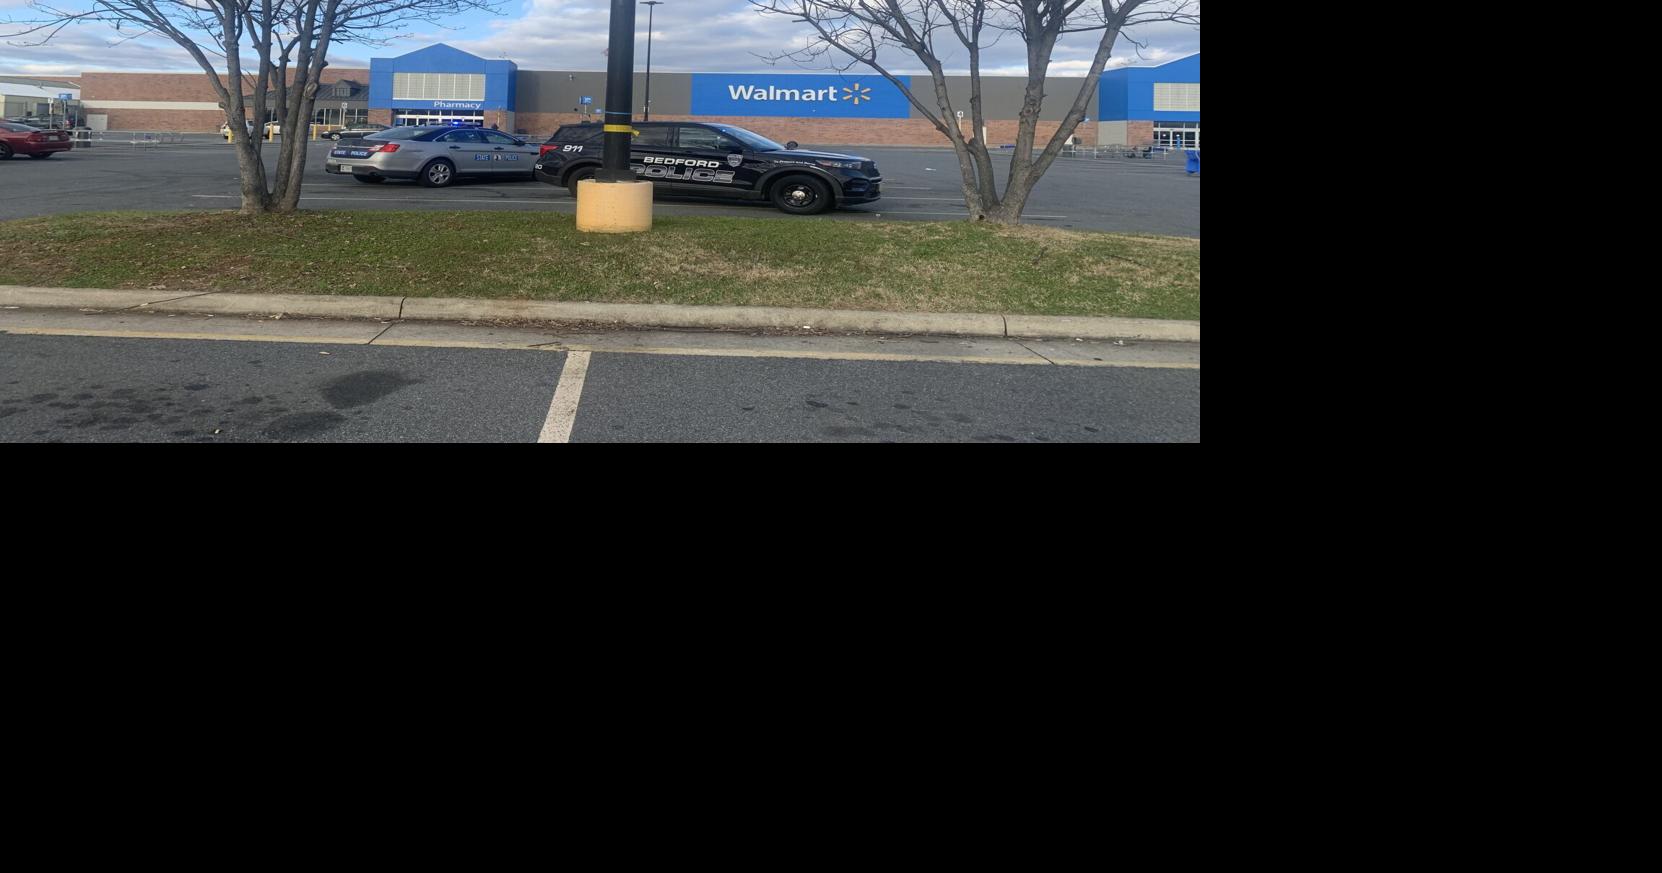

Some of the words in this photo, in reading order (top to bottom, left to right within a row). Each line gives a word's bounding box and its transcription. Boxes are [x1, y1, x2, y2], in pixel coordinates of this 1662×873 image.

[728, 84, 838, 101] Walmart
[433, 101, 481, 110] Pharmacy
[562, 144, 584, 152] 911
[643, 156, 720, 168] BEDFORD
